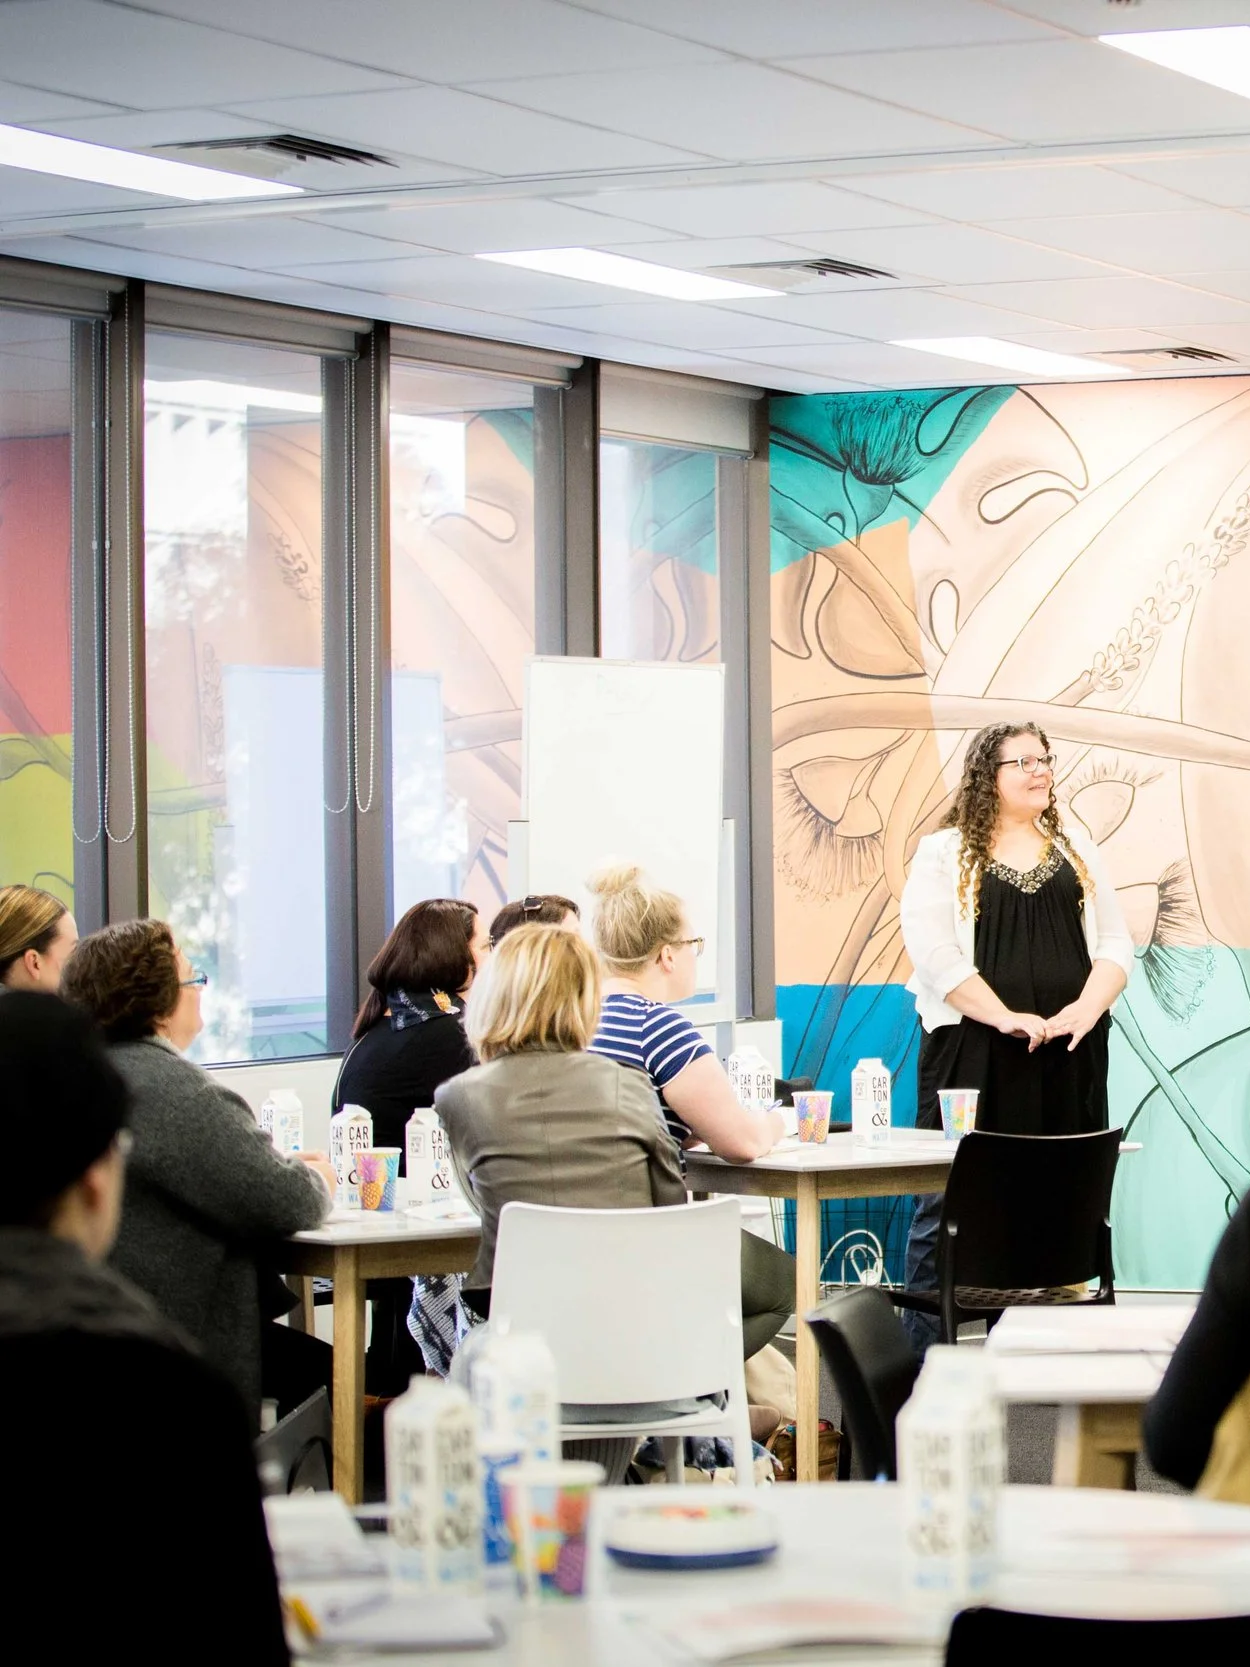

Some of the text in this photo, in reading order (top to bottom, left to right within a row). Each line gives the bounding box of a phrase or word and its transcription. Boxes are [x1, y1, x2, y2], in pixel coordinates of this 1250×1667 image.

[756, 1074, 772, 1087] CAR
[872, 1076, 888, 1089] CAR
[757, 1087, 772, 1099] TON
[873, 1090, 888, 1102] TON
[348, 1125, 369, 1141] CAR
